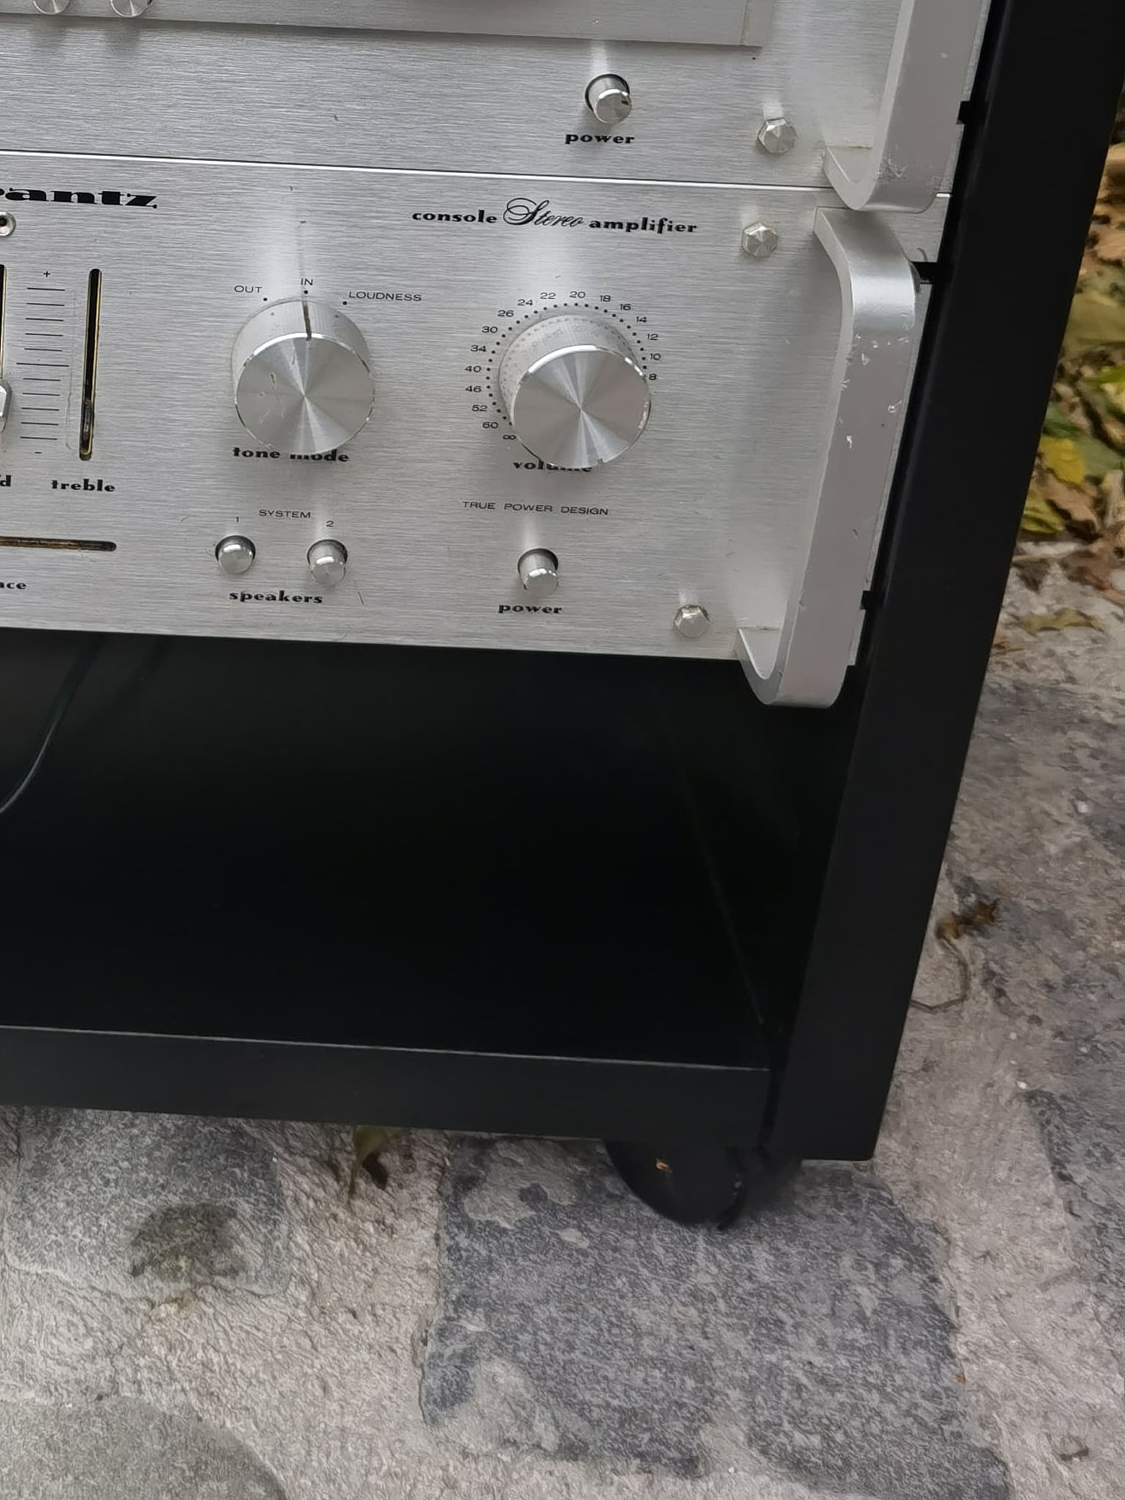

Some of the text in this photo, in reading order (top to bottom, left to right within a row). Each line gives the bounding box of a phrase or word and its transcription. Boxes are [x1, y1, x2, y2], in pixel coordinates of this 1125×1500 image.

[565, 134, 635, 145] power
[412, 197, 697, 234] console Stereo amplifier
[301, 278, 313, 286] IN
[234, 285, 262, 294] OUT
[348, 292, 422, 301] LOUDNESS
[569, 291, 586, 299] 20
[482, 326, 498, 334] 30
[470, 345, 486, 353] 34
[482, 421, 499, 429] 60
[233, 447, 280, 459] tone
[51, 479, 115, 493] treble
[462, 500, 608, 516] TRUE POWER DESIGN
[259, 509, 312, 518] SYSTEM
[229, 589, 323, 604] speakers
[498, 603, 562, 615] power
